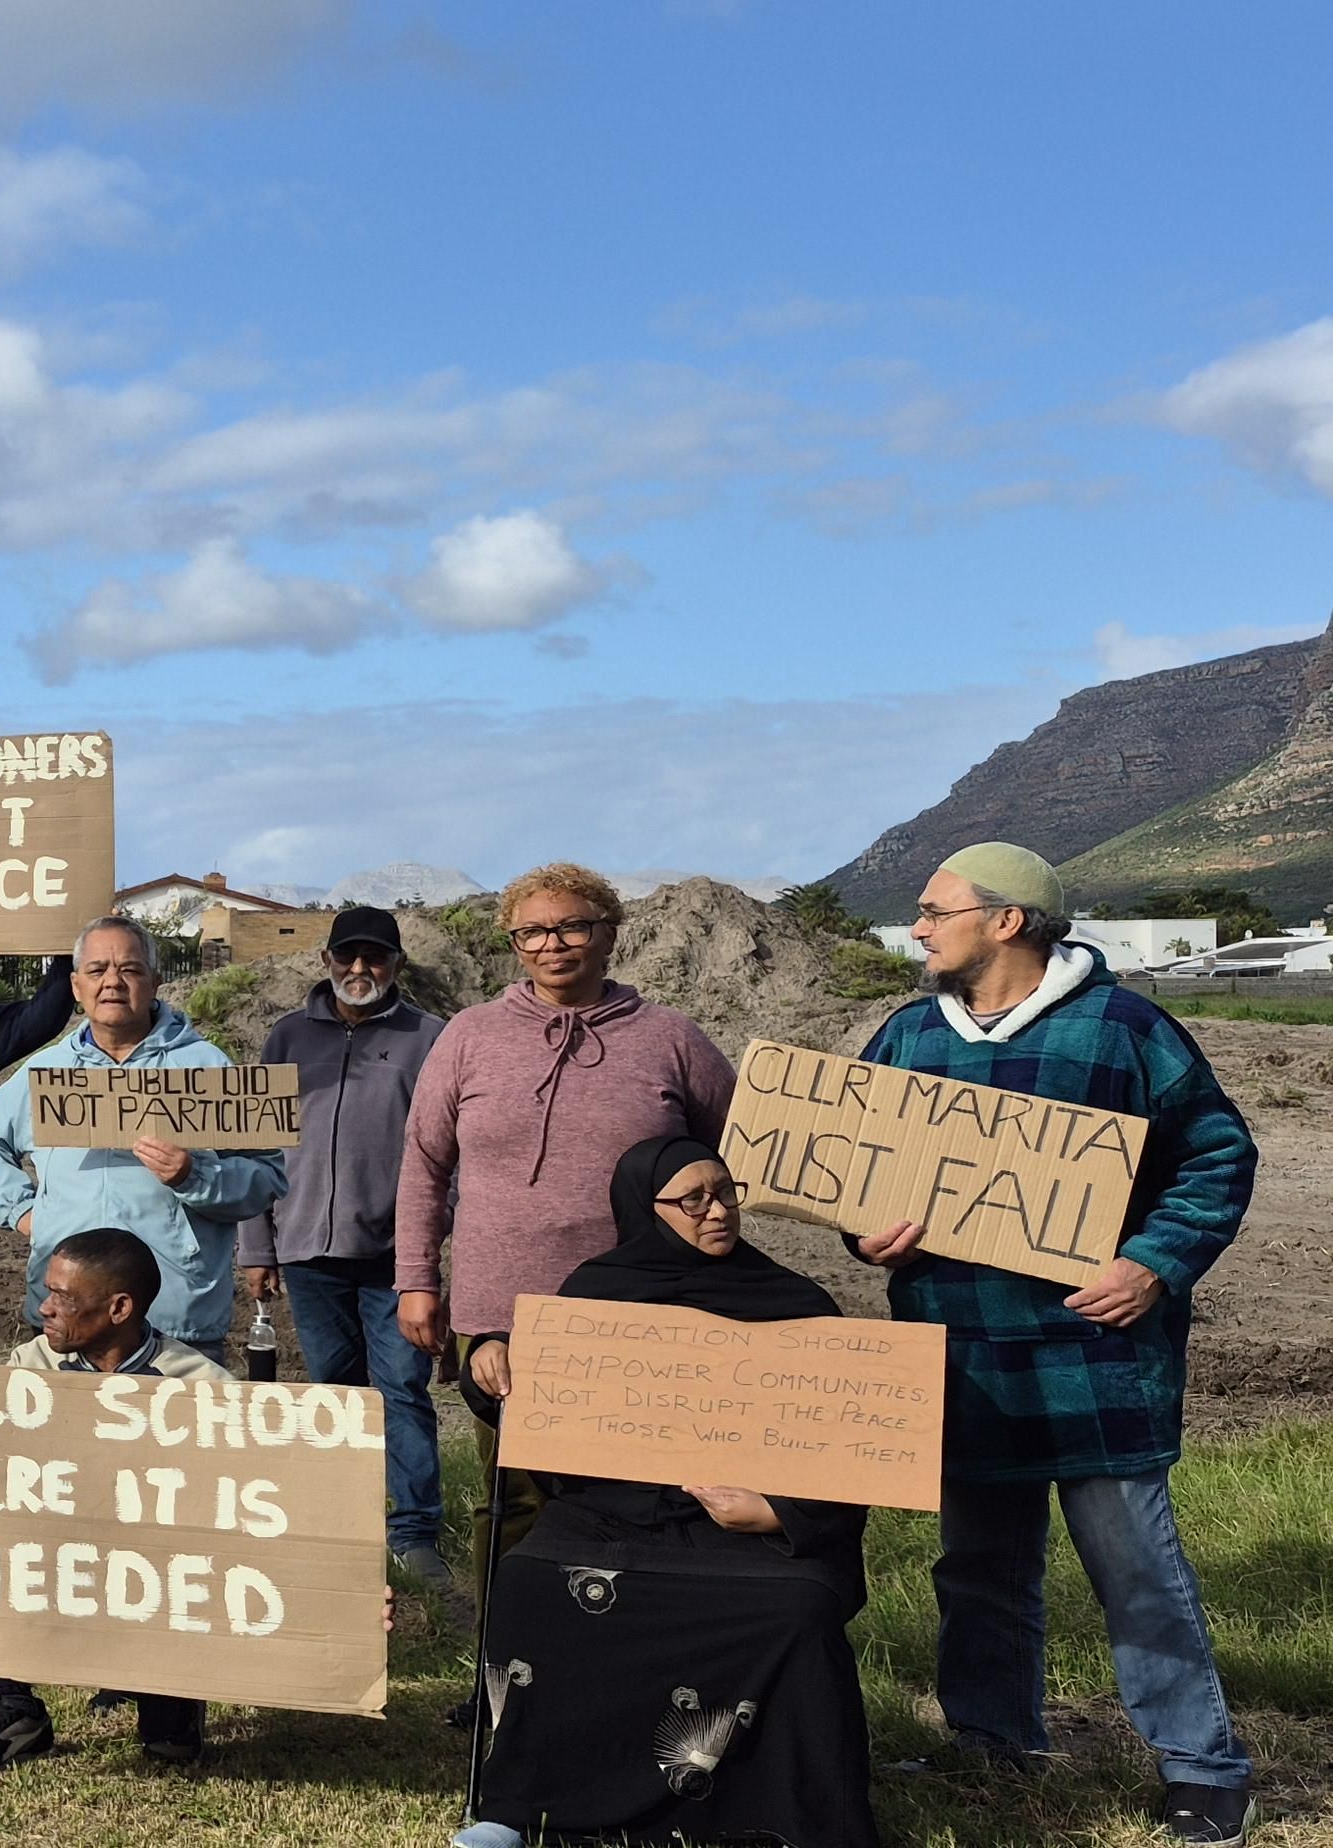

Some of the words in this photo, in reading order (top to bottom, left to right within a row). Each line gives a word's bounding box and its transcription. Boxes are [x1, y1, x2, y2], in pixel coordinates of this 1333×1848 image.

[33, 1067, 88, 1088] THIS
[108, 1068, 206, 1095] PUBLIC
[222, 1066, 269, 1095] DID
[40, 1093, 104, 1127] NOT
[118, 1095, 301, 1133] PARTICIPATE
[747, 1047, 878, 1114] CLLR.
[897, 1075, 1134, 1179] MARITA
[723, 1122, 894, 1207] MUST
[920, 1156, 1100, 1265] FALL
[93, 1375, 386, 1450] SCHOOL
[524, 1411, 564, 1431] OF
[625, 1387, 755, 1417] DISRUPT
[773, 1402, 825, 1422] THE
[115, 1467, 187, 1525] IT
[214, 1477, 288, 1538] IS
